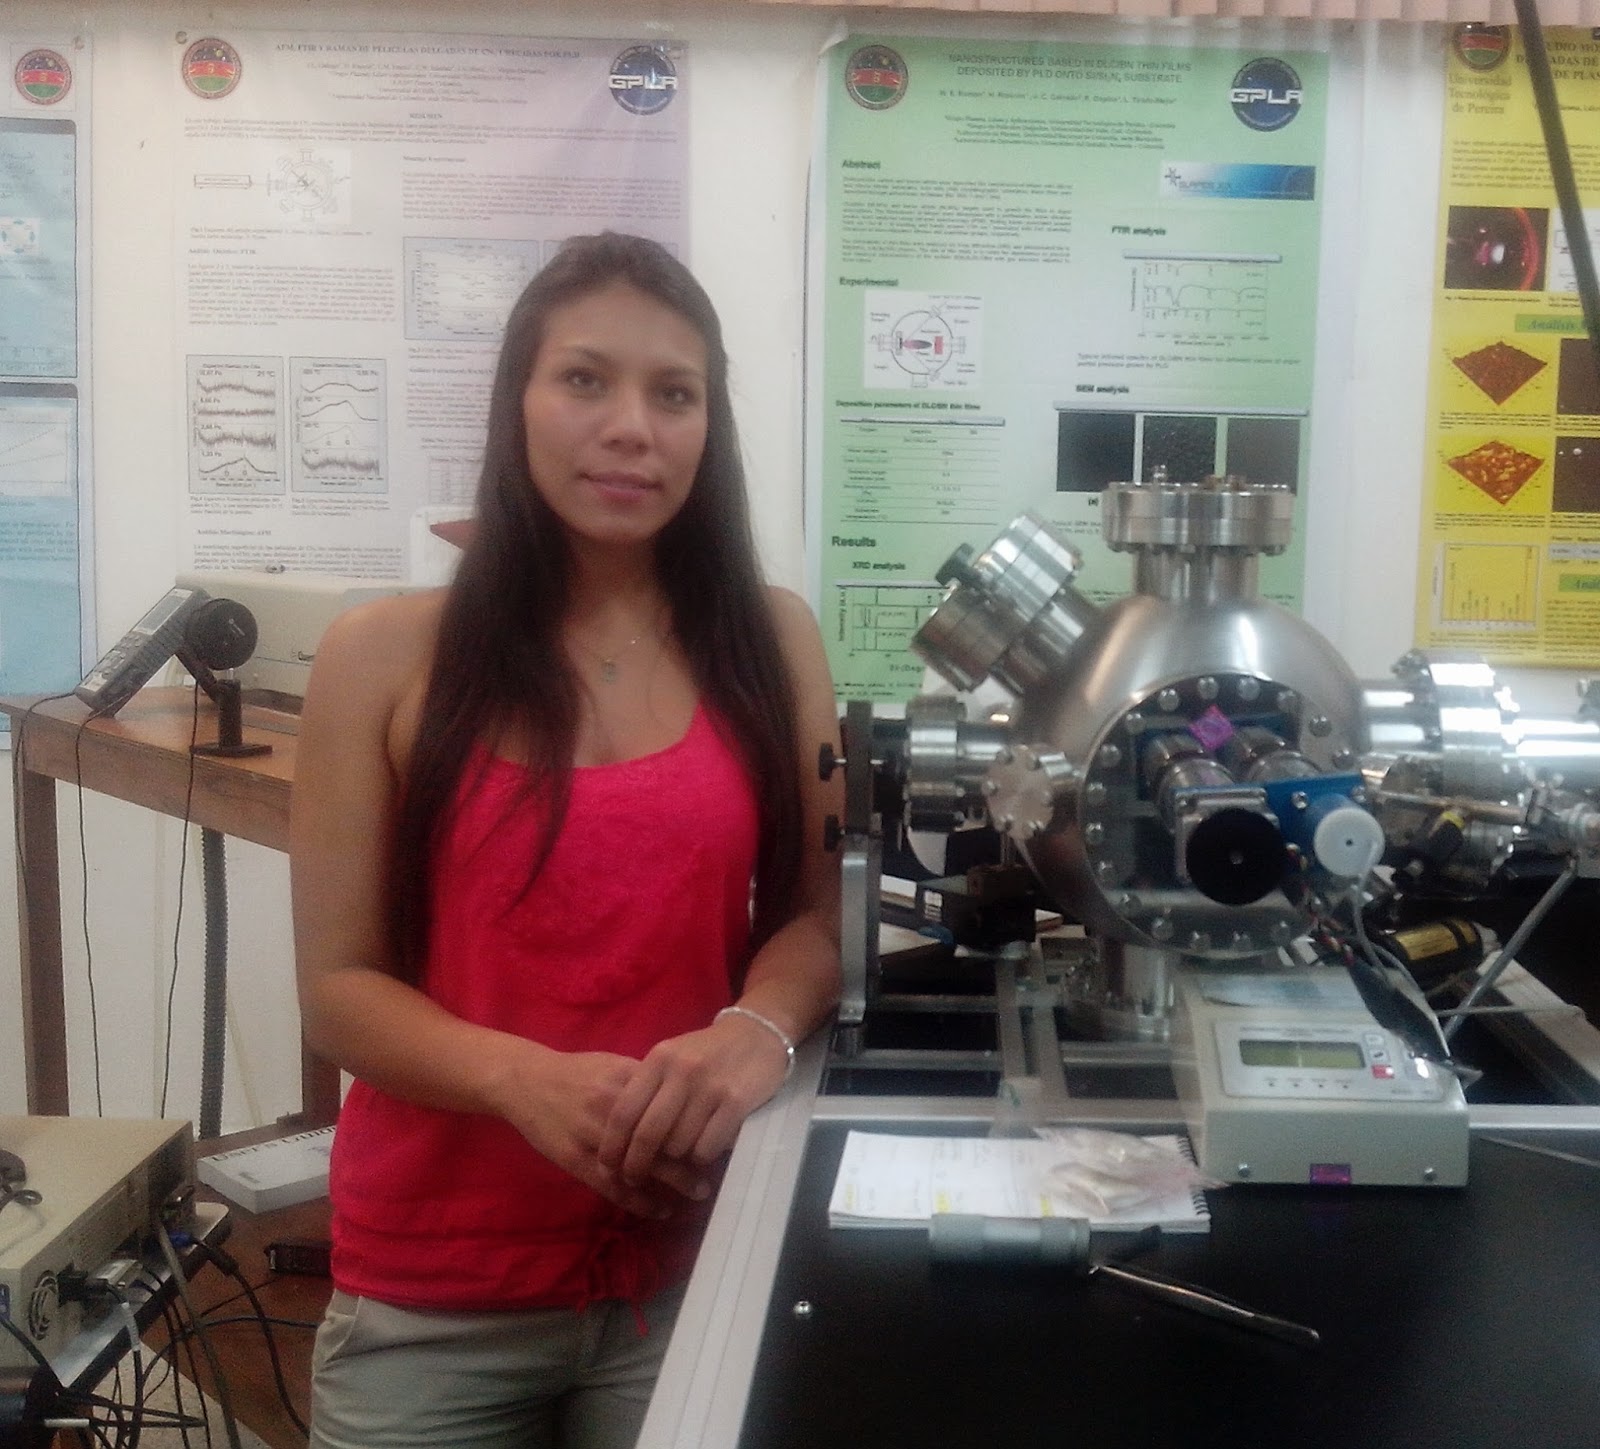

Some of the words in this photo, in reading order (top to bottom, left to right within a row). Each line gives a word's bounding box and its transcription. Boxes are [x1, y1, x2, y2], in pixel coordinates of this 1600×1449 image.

[957, 66, 1015, 78] DEPOSITED
[1016, 68, 1030, 78] BY
[1124, 73, 1182, 84] SUBSTRATE
[609, 74, 677, 90] GPLA
[1230, 88, 1302, 105] GPLA
[842, 159, 881, 170] Abstract
[1133, 226, 1166, 237] analysis
[839, 276, 899, 287] Experimental
[1096, 385, 1130, 396] analysis
[832, 535, 877, 547] Results
[872, 562, 906, 572] analysis
